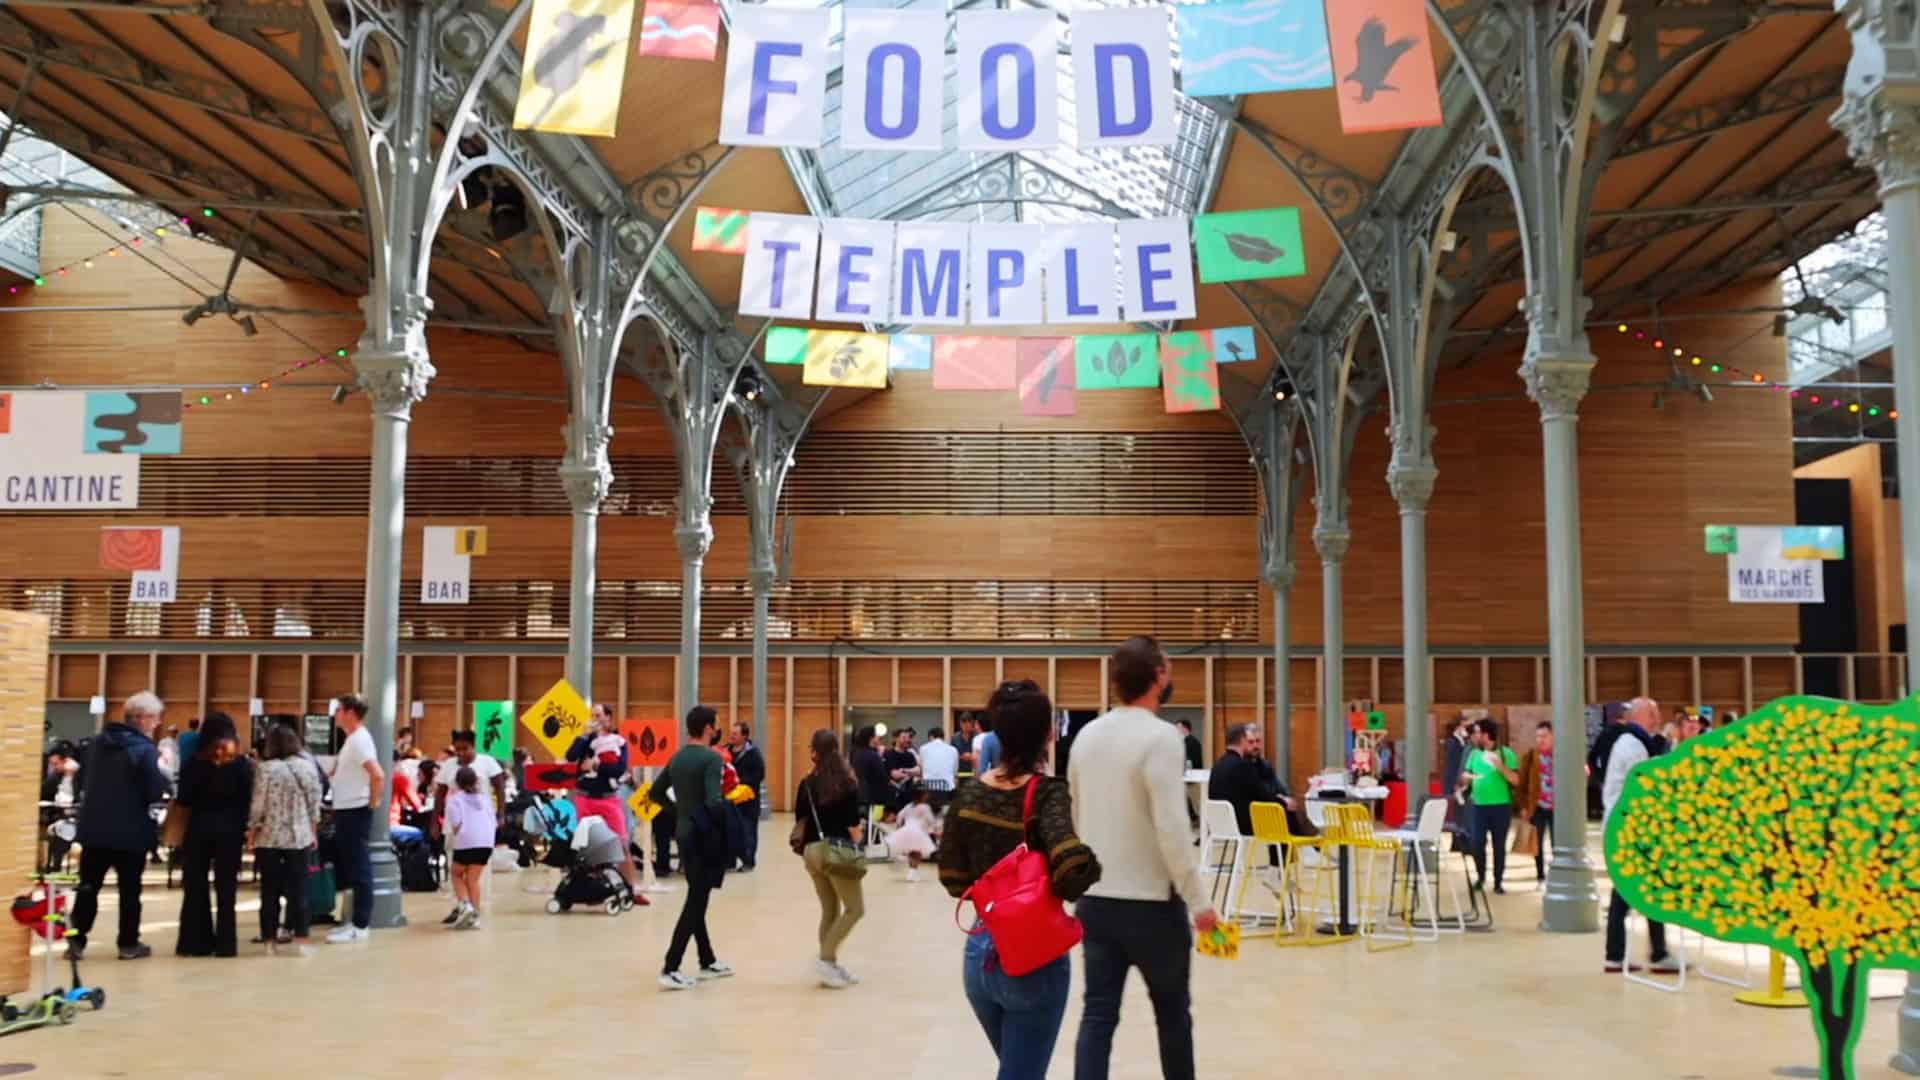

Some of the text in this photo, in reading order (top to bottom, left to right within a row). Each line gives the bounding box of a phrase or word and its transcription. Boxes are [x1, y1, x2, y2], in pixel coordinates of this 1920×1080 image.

[746, 41, 1153, 140] FOOD
[762, 240, 1177, 317] TEMPLE
[6, 475, 123, 503] CANTINE
[135, 581, 169, 599] BAR
[427, 581, 462, 599] BAR
